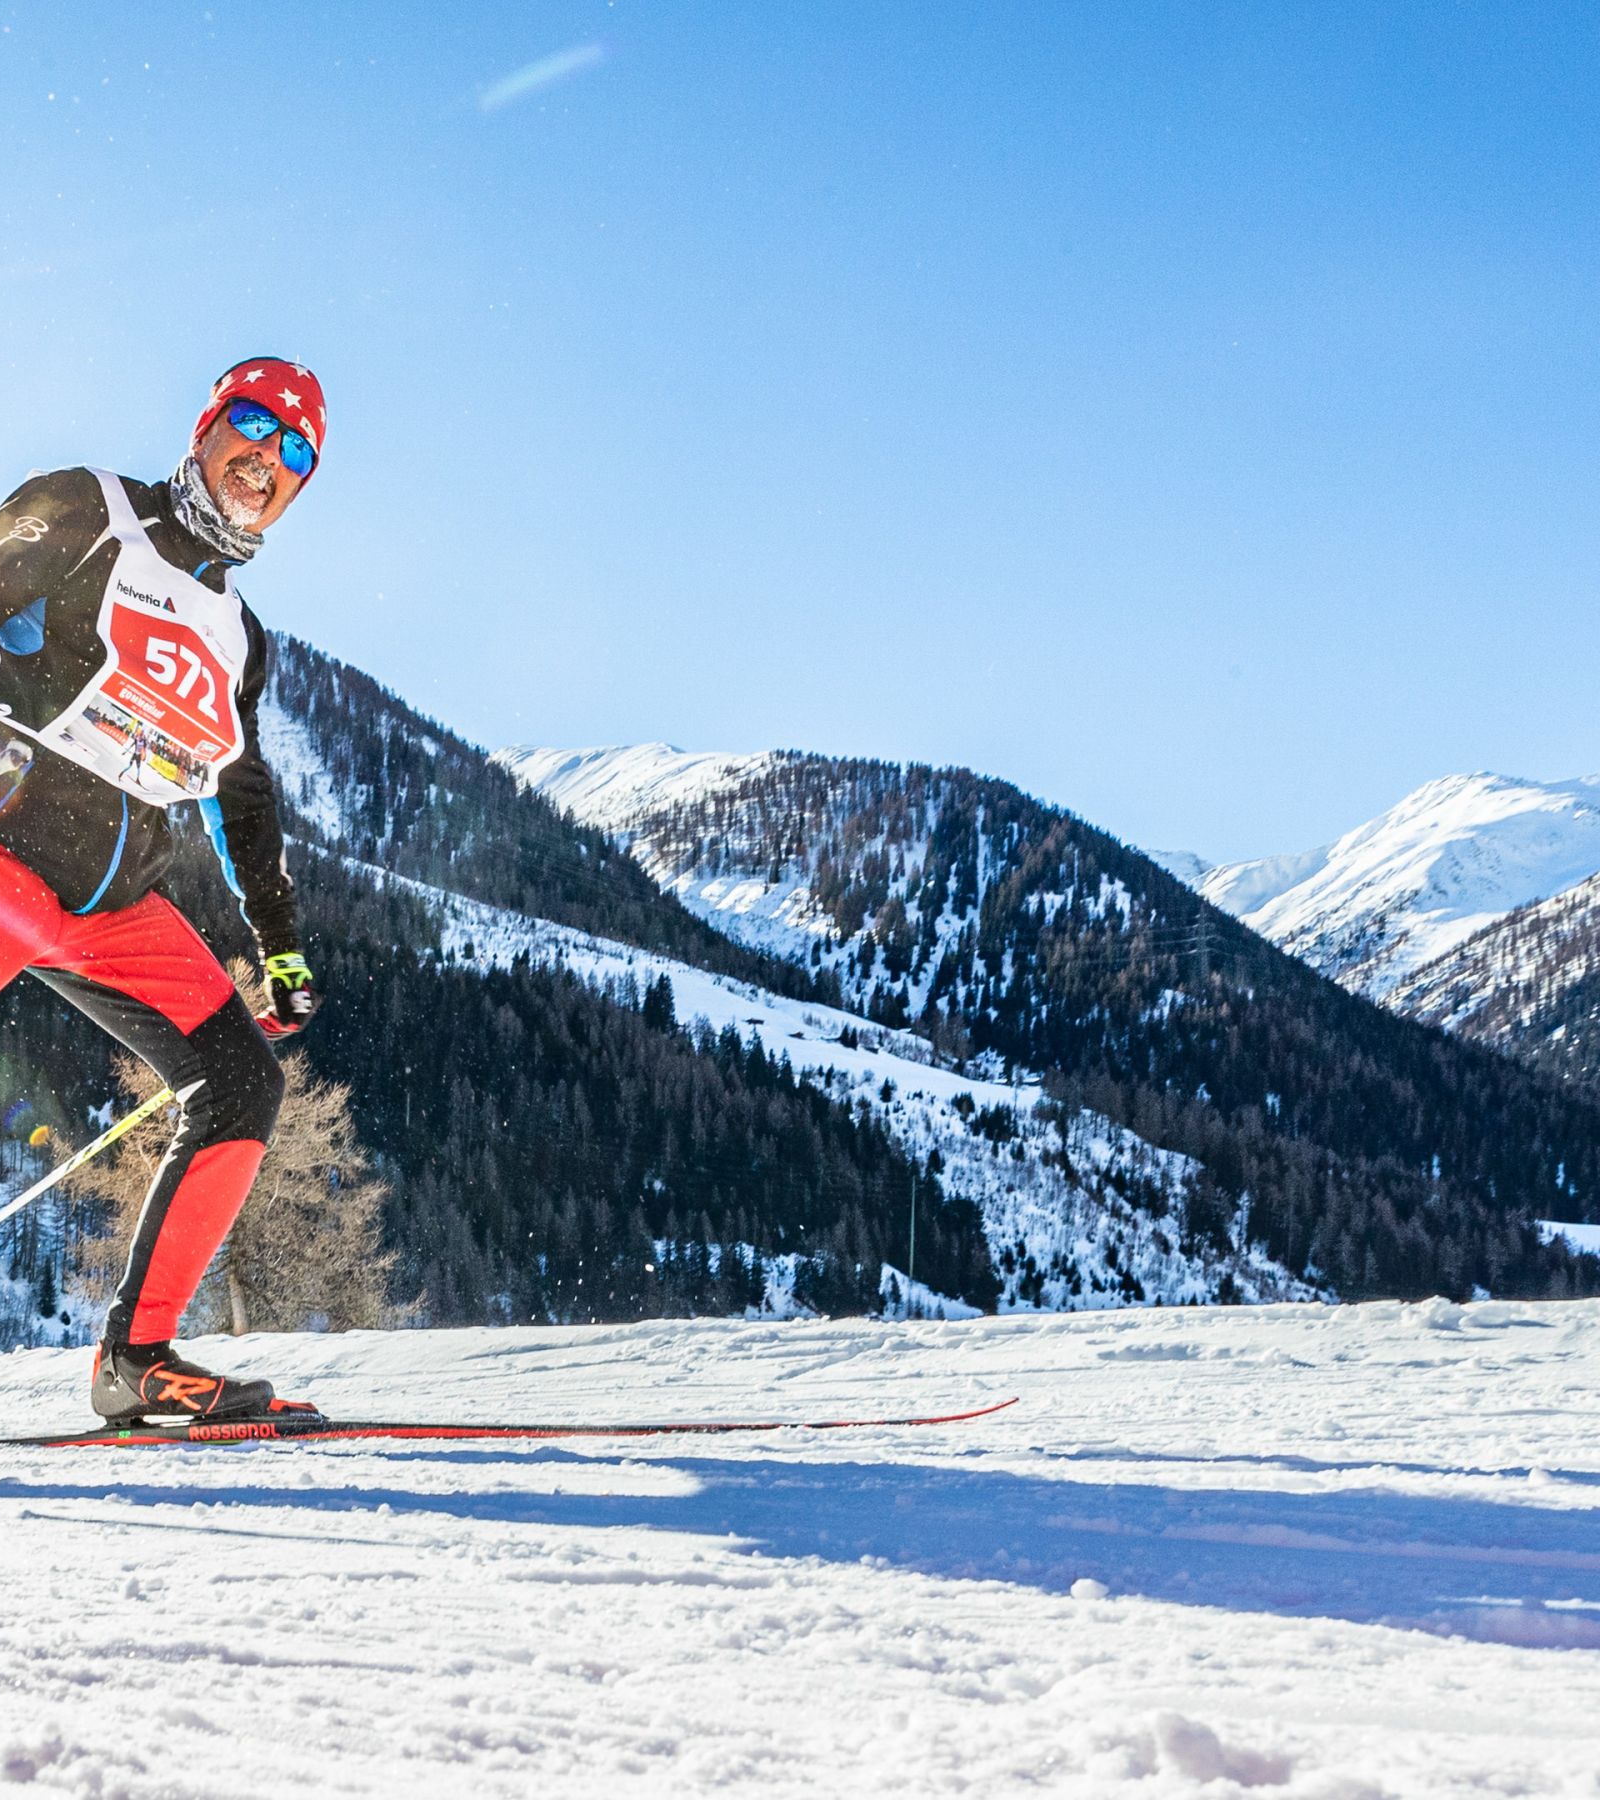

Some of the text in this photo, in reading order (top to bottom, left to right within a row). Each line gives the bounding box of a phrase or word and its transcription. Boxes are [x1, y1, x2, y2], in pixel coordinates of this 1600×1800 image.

[116, 579, 161, 607] helvetia
[144, 635, 220, 724] 572
[188, 1423, 281, 1441] ROSSIGNOL
